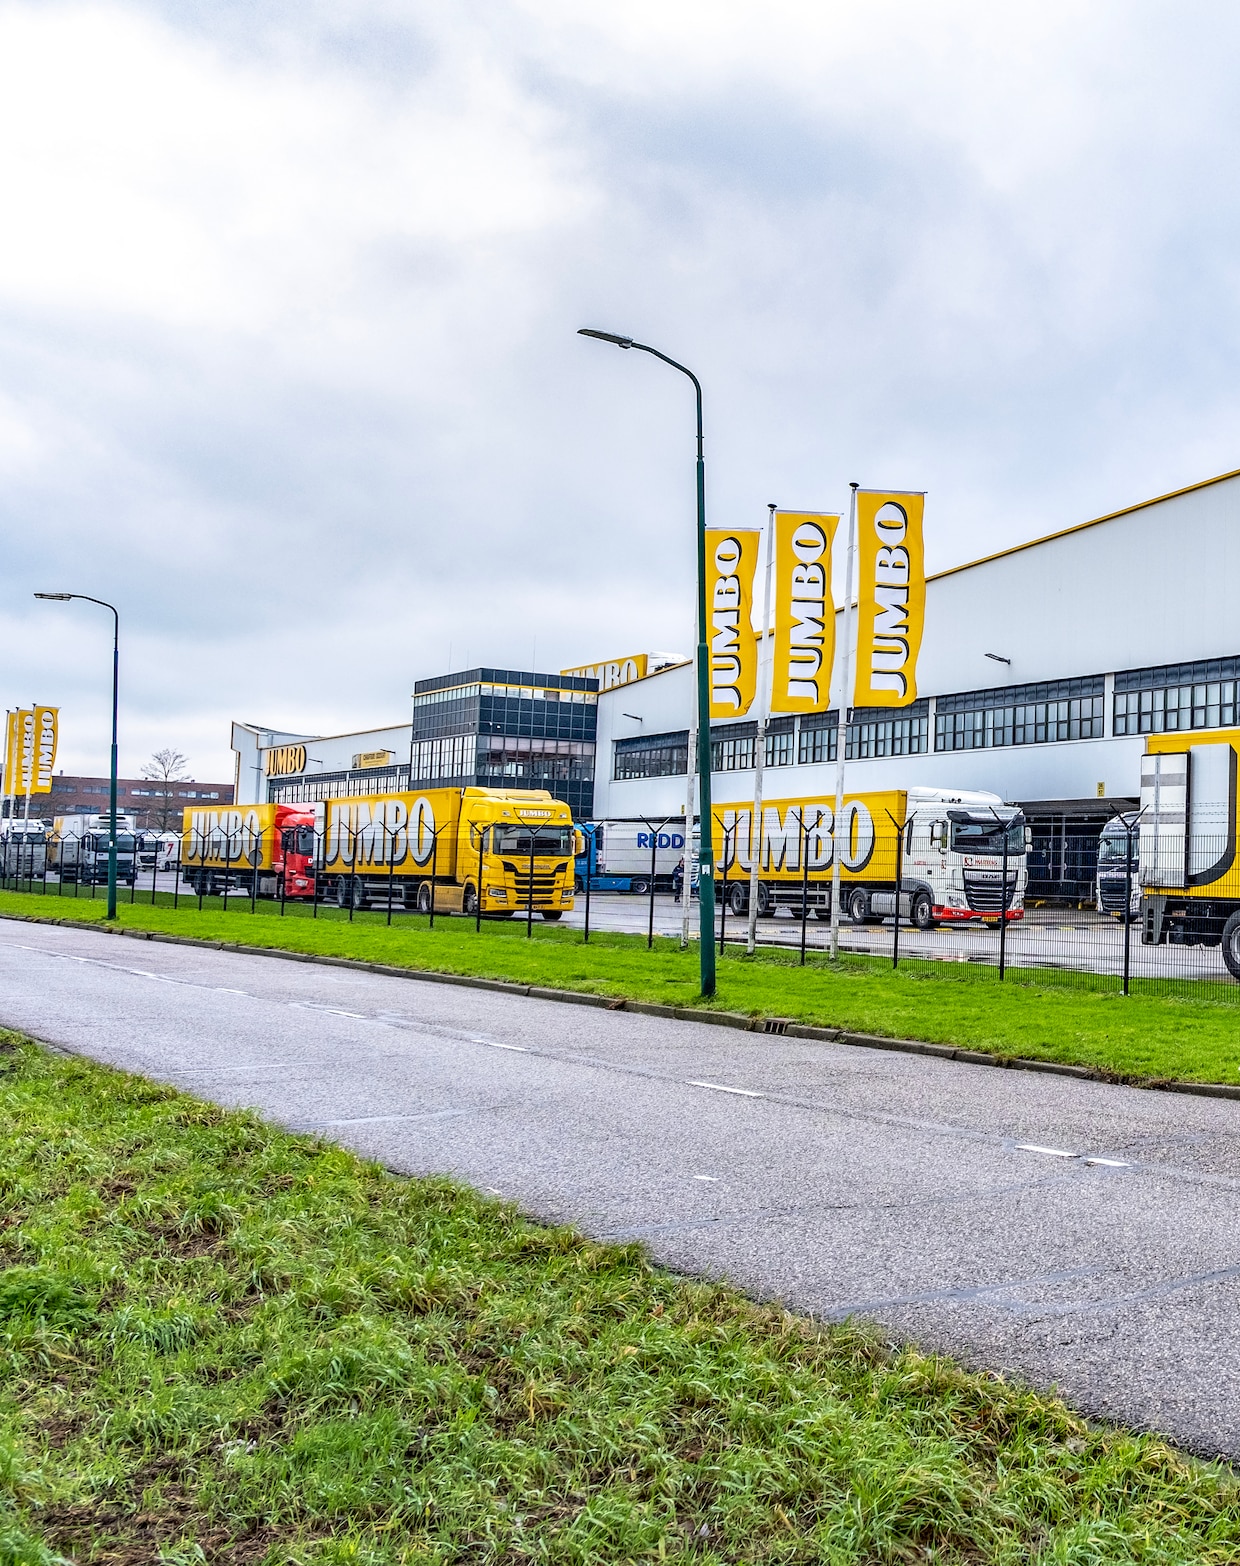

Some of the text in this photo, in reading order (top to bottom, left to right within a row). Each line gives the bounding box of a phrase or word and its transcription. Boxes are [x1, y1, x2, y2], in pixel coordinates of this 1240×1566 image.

[711, 536, 743, 711] JUMBO
[787, 521, 827, 705] JUMBO
[870, 501, 910, 699] JUMBO
[265, 745, 307, 776] JUMBO
[188, 809, 261, 863] JUMBO
[326, 796, 436, 867] JUMBO
[520, 809, 552, 817] JUMBO
[716, 799, 875, 872] JUMBO
